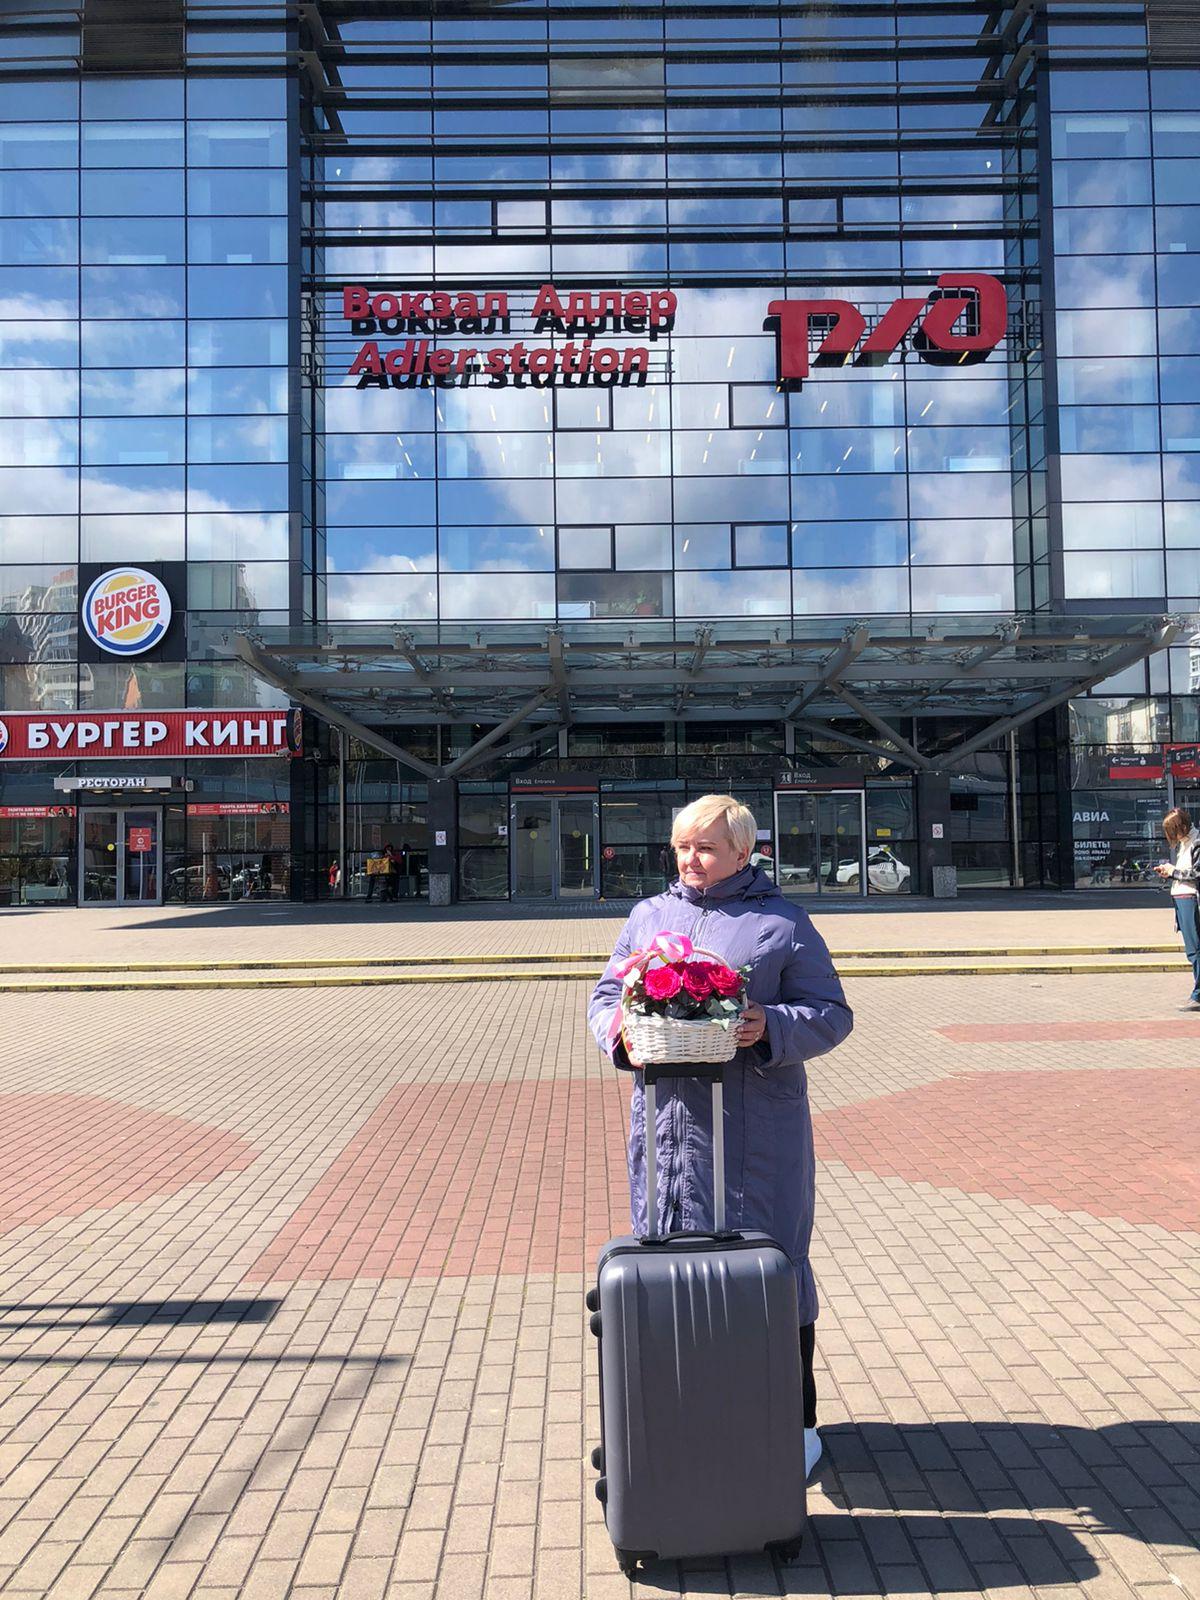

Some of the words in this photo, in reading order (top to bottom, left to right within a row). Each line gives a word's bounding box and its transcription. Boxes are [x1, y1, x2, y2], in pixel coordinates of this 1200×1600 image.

[343, 286, 508, 320] Вокзал
[531, 284, 678, 326] Адлер
[348, 339, 478, 376] Adler
[483, 340, 650, 376] station
[94, 583, 158, 616] BURGER
[96, 597, 161, 638] KING
[28, 721, 168, 749] БУРГЕР
[185, 719, 287, 747] КИНГ
[78, 776, 146, 788] РЕСТОРАН
[1073, 811, 1110, 822] АВИА
[1074, 841, 1110, 849] БИЛЕТЫ
